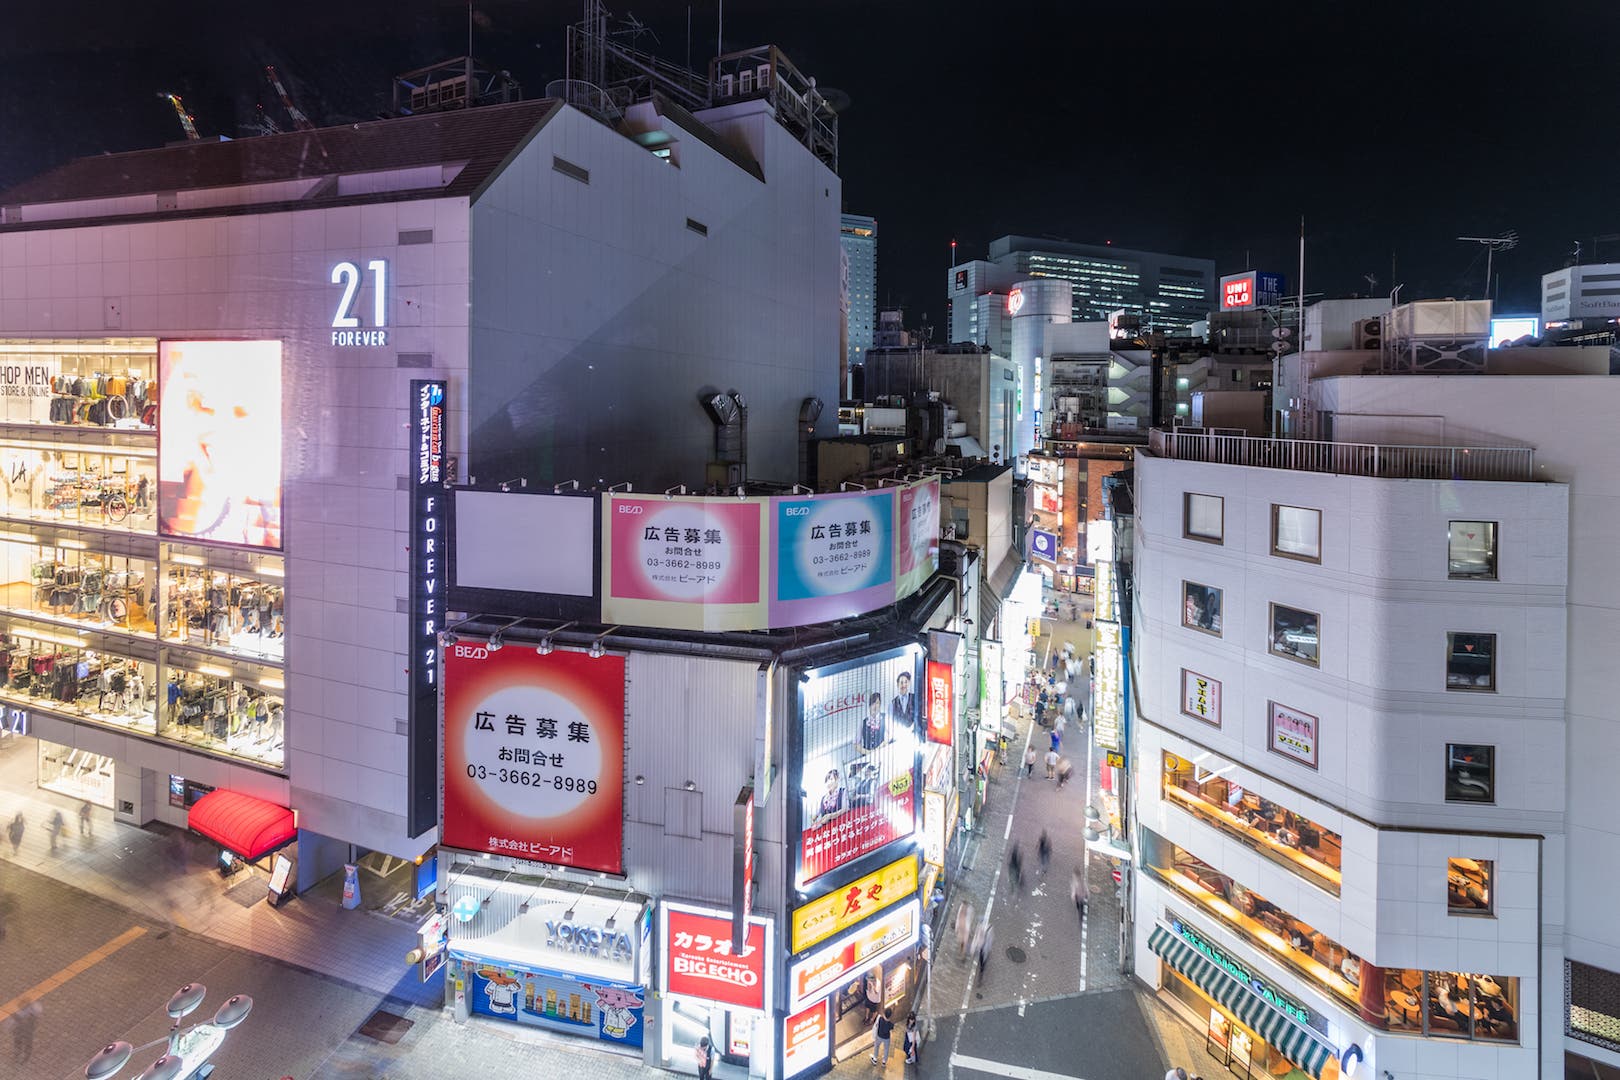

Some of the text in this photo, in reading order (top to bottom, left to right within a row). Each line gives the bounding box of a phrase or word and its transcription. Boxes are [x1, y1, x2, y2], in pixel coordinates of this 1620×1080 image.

[331, 260, 385, 328] 21
[1227, 282, 1247, 294] UNI
[1263, 276, 1278, 292] THE
[1227, 293, 1249, 306] QLO
[332, 330, 386, 346] FOREVER
[25, 366, 49, 386] MEN
[1, 385, 20, 397] STORE
[28, 386, 49, 398] ONLINE
[644, 526, 722, 545] 広告募集
[811, 520, 872, 540] 広告募集
[665, 546, 703, 557] お問合せ
[829, 540, 859, 551] お問合せ
[647, 557, 721, 570] 03-3662-8989
[812, 549, 872, 565] 03-3662-8989
[425, 497, 436, 684] FOREVER 21
[11, 709, 27, 737] 21
[474, 711, 590, 744] 広告募集
[498, 746, 564, 768] お問合せ
[467, 764, 597, 794] 03-3662-8989
[545, 919, 632, 952] YOKOTA
[1172, 918, 1250, 985] EXCELSIOR
[674, 957, 758, 986] BIG ECHO
